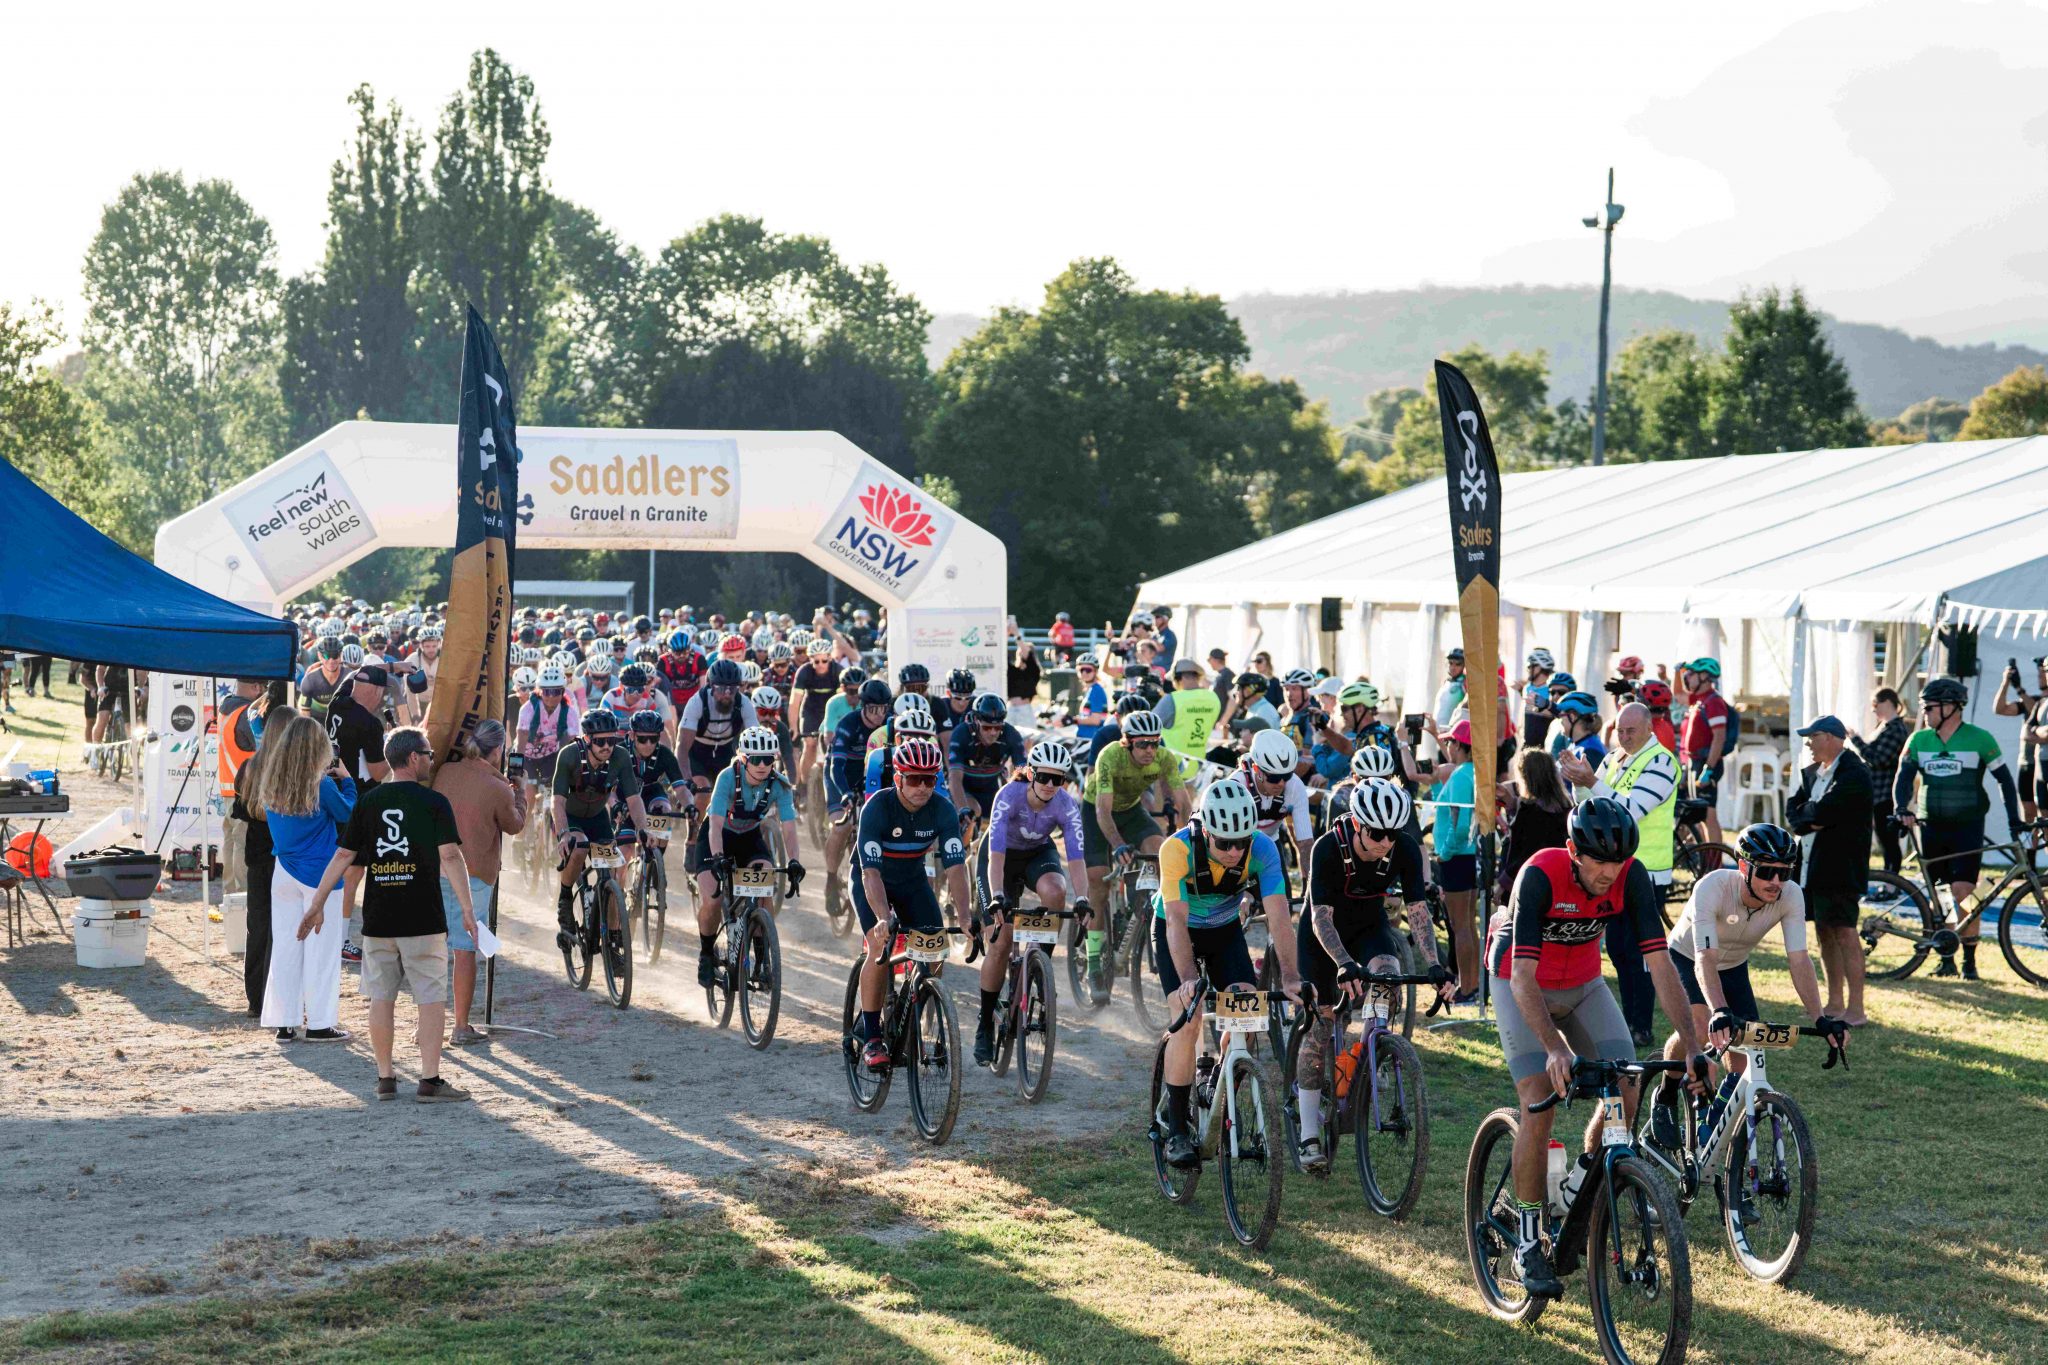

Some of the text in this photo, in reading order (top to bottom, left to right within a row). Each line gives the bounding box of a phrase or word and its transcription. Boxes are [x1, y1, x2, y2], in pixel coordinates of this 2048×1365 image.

[550, 454, 730, 497] Saddlers
[248, 488, 328, 541] feel new
[298, 499, 351, 536] south
[570, 505, 708, 522] Gravel n Granite
[307, 515, 361, 550] wales
[836, 516, 919, 578] NSW
[828, 540, 902, 589] GOVERNMENT
[193, 807, 211, 815] BUL
[371, 861, 417, 874] Saddlers
[742, 872, 768, 883] 537
[1022, 917, 1051, 929] 263
[915, 936, 944, 949] 369
[1226, 994, 1259, 1012] 402
[1753, 1028, 1790, 1043] 503
